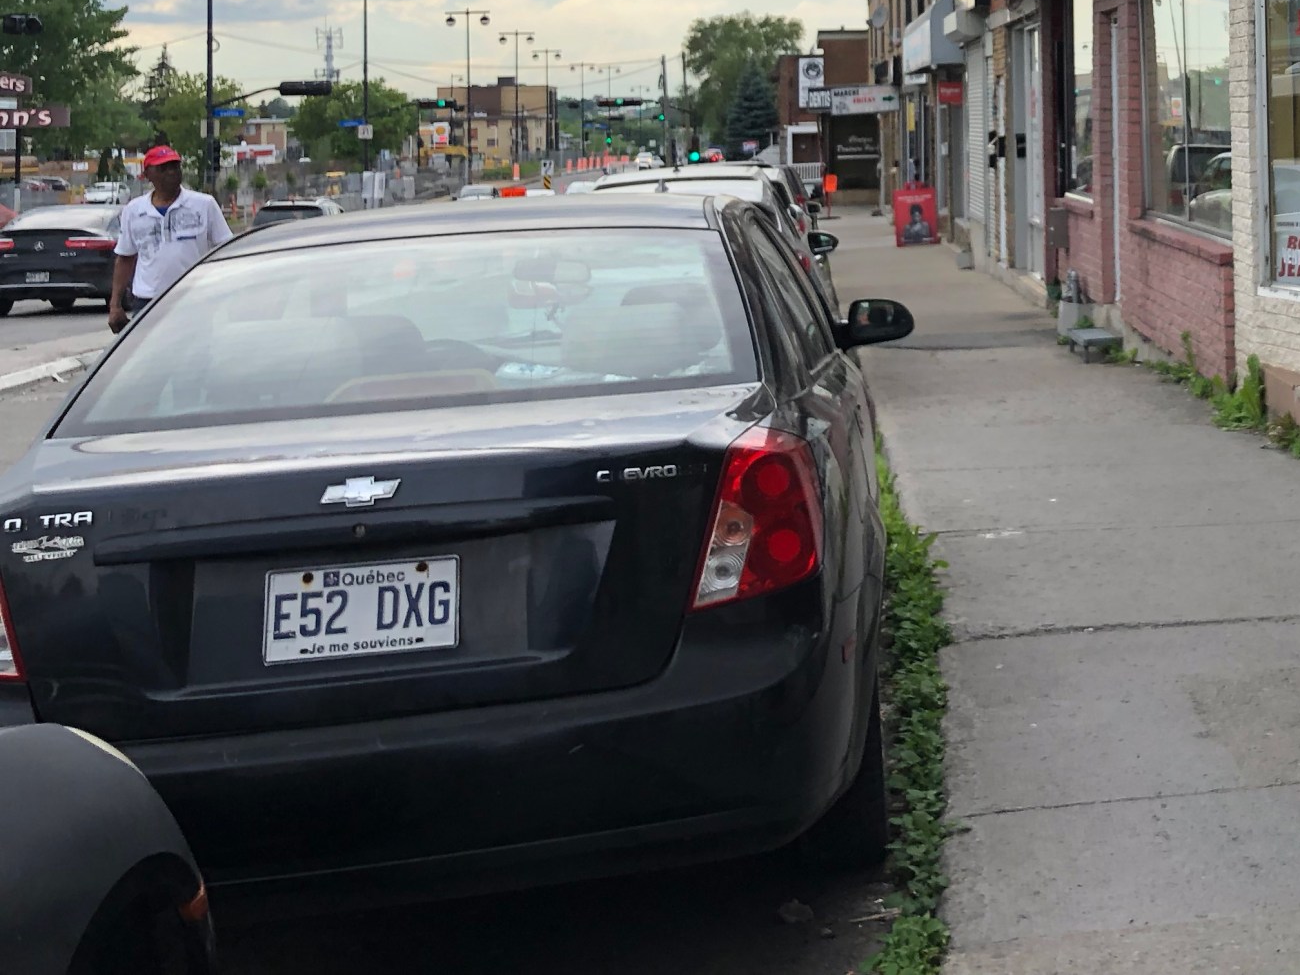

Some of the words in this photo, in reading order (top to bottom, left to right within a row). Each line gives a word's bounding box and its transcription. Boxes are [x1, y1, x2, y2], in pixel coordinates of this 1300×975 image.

[342, 570, 405, 587] Québec
[273, 589, 349, 640] E52
[377, 581, 450, 631] DXG
[329, 641, 349, 652] me
[353, 636, 413, 651] souviens
